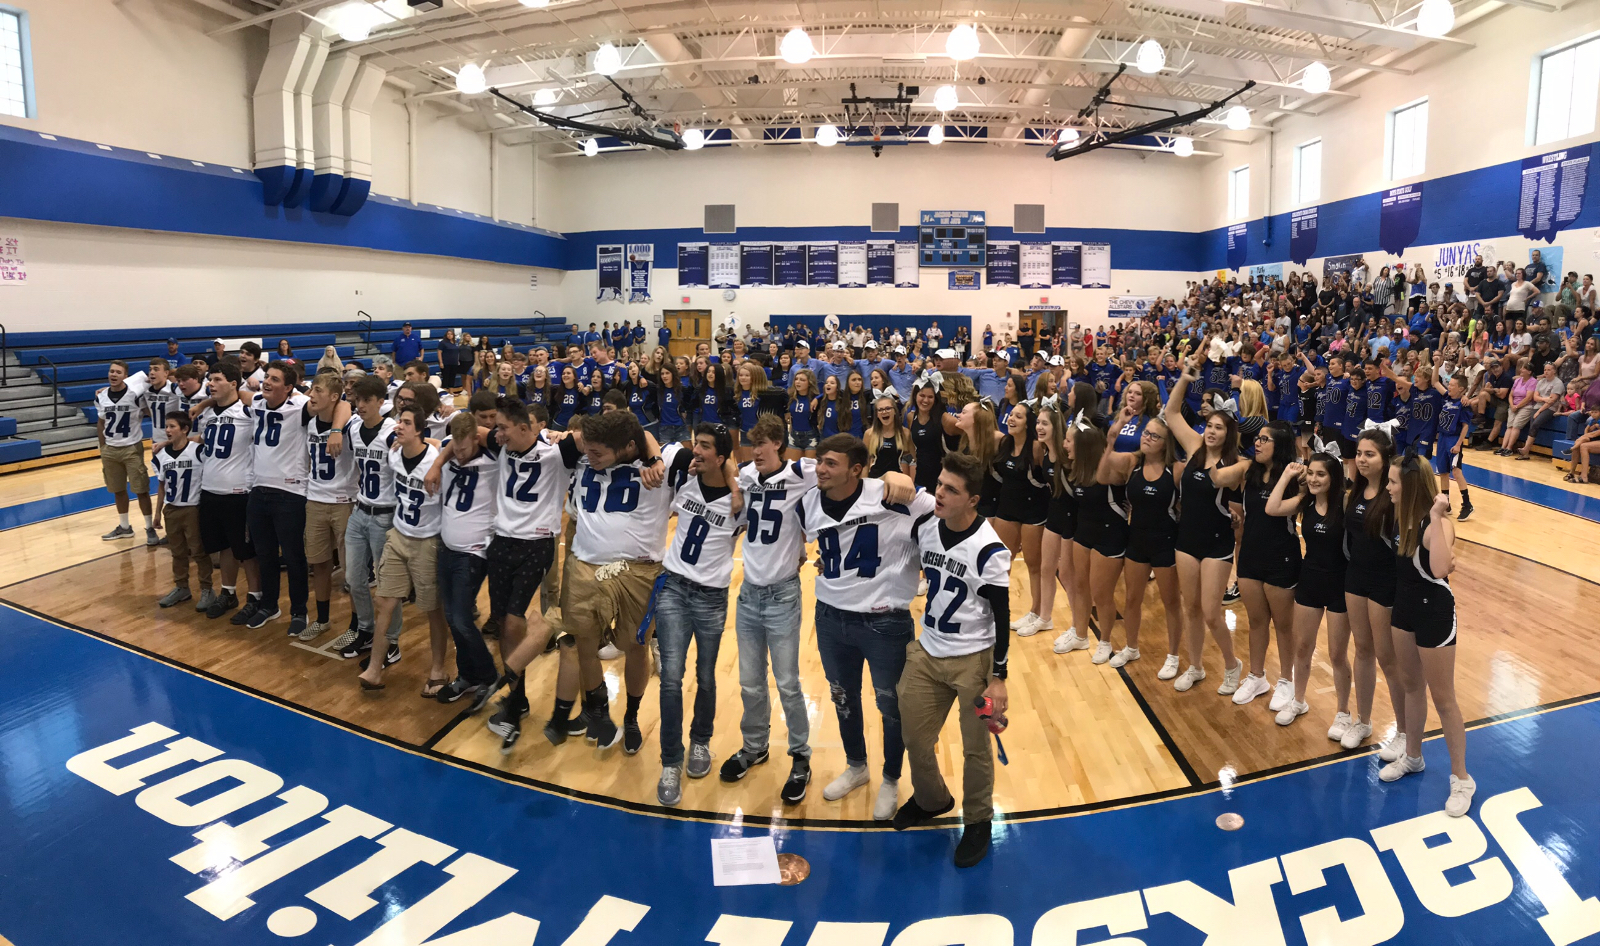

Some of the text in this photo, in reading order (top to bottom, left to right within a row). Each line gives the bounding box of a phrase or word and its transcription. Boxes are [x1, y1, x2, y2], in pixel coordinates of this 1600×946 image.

[1436, 243, 1480, 267] JUNYAS
[582, 367, 588, 375] 8
[563, 394, 574, 405] 26
[666, 392, 672, 402] 2
[704, 394, 716, 404] 23
[105, 412, 131, 438] 24
[150, 402, 166, 429] 11
[254, 410, 283, 447] 76
[826, 408, 832, 418] 6
[204, 424, 236, 459] 99
[1120, 424, 1136, 436] 22
[310, 442, 336, 480] 15
[166, 469, 192, 502] 31
[444, 466, 480, 512] 78
[506, 458, 542, 502] 12
[581, 464, 641, 513] 56
[682, 498, 726, 528] JACKSON-MILTON
[680, 514, 710, 566] 8
[818, 524, 882, 579] 84
[922, 550, 968, 578] JACKSON-MILTON
[924, 566, 968, 634] 22
[705, 787, 1600, 946] Jacks
